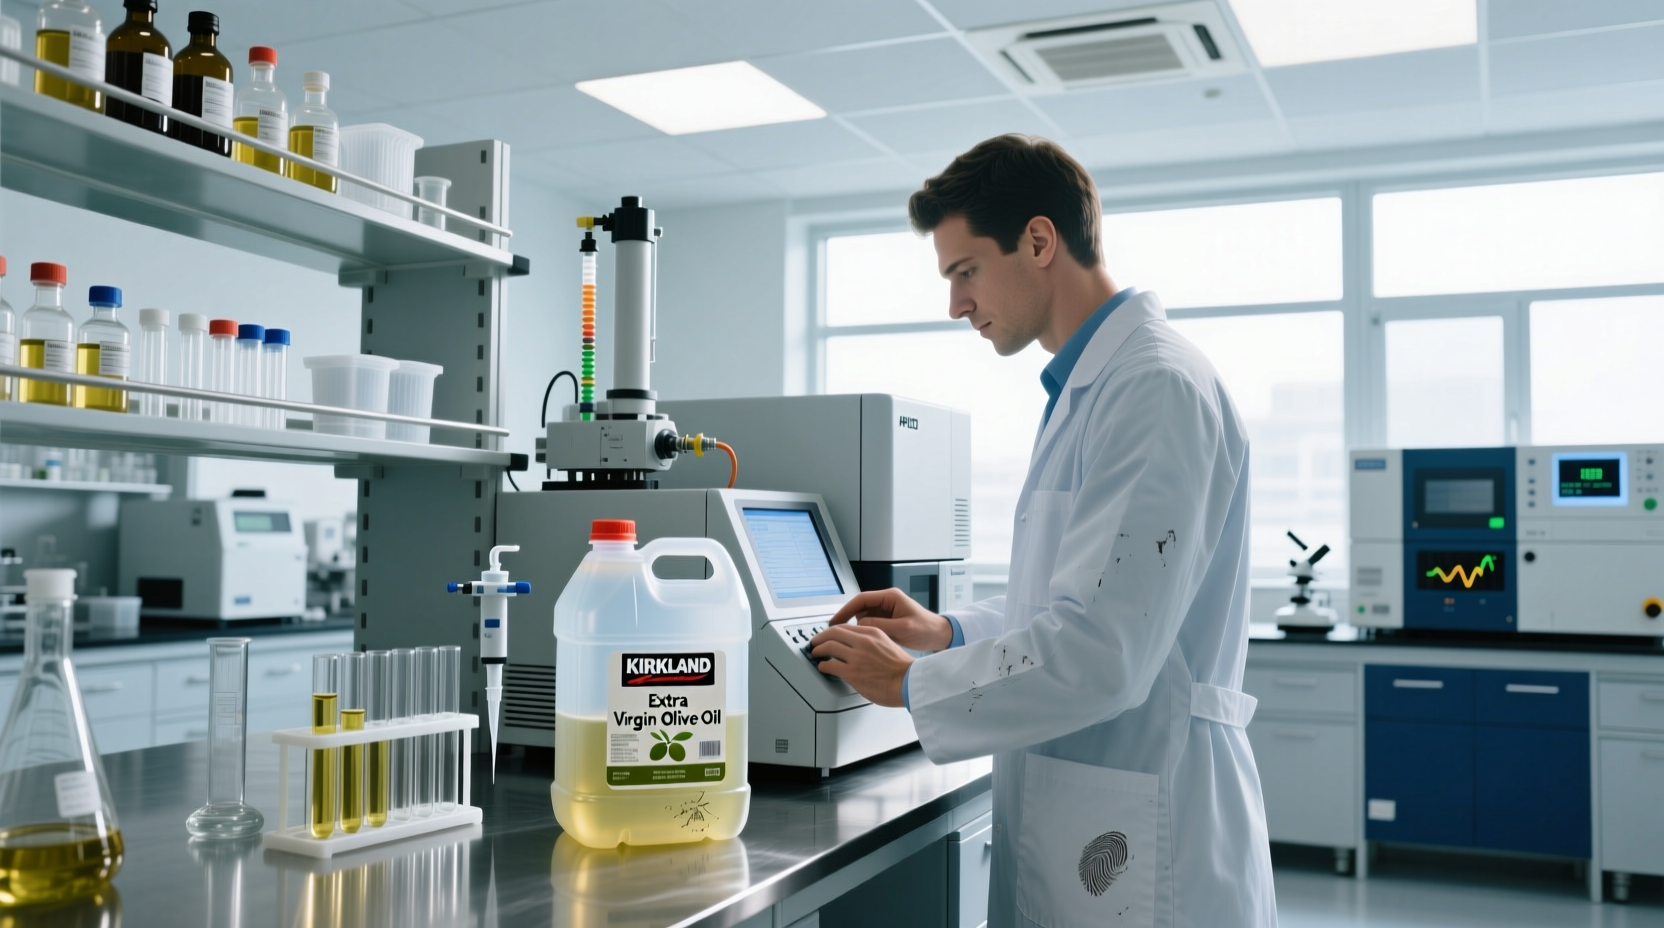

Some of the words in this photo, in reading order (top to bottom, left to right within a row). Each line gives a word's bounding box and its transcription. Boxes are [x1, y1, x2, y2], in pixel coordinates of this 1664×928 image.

[626, 657, 712, 675] KIRKLAND
[648, 693, 689, 708] Extra
[613, 711, 657, 731] Virgin
[661, 710, 699, 726] Olive
[701, 709, 721, 725] Oil
